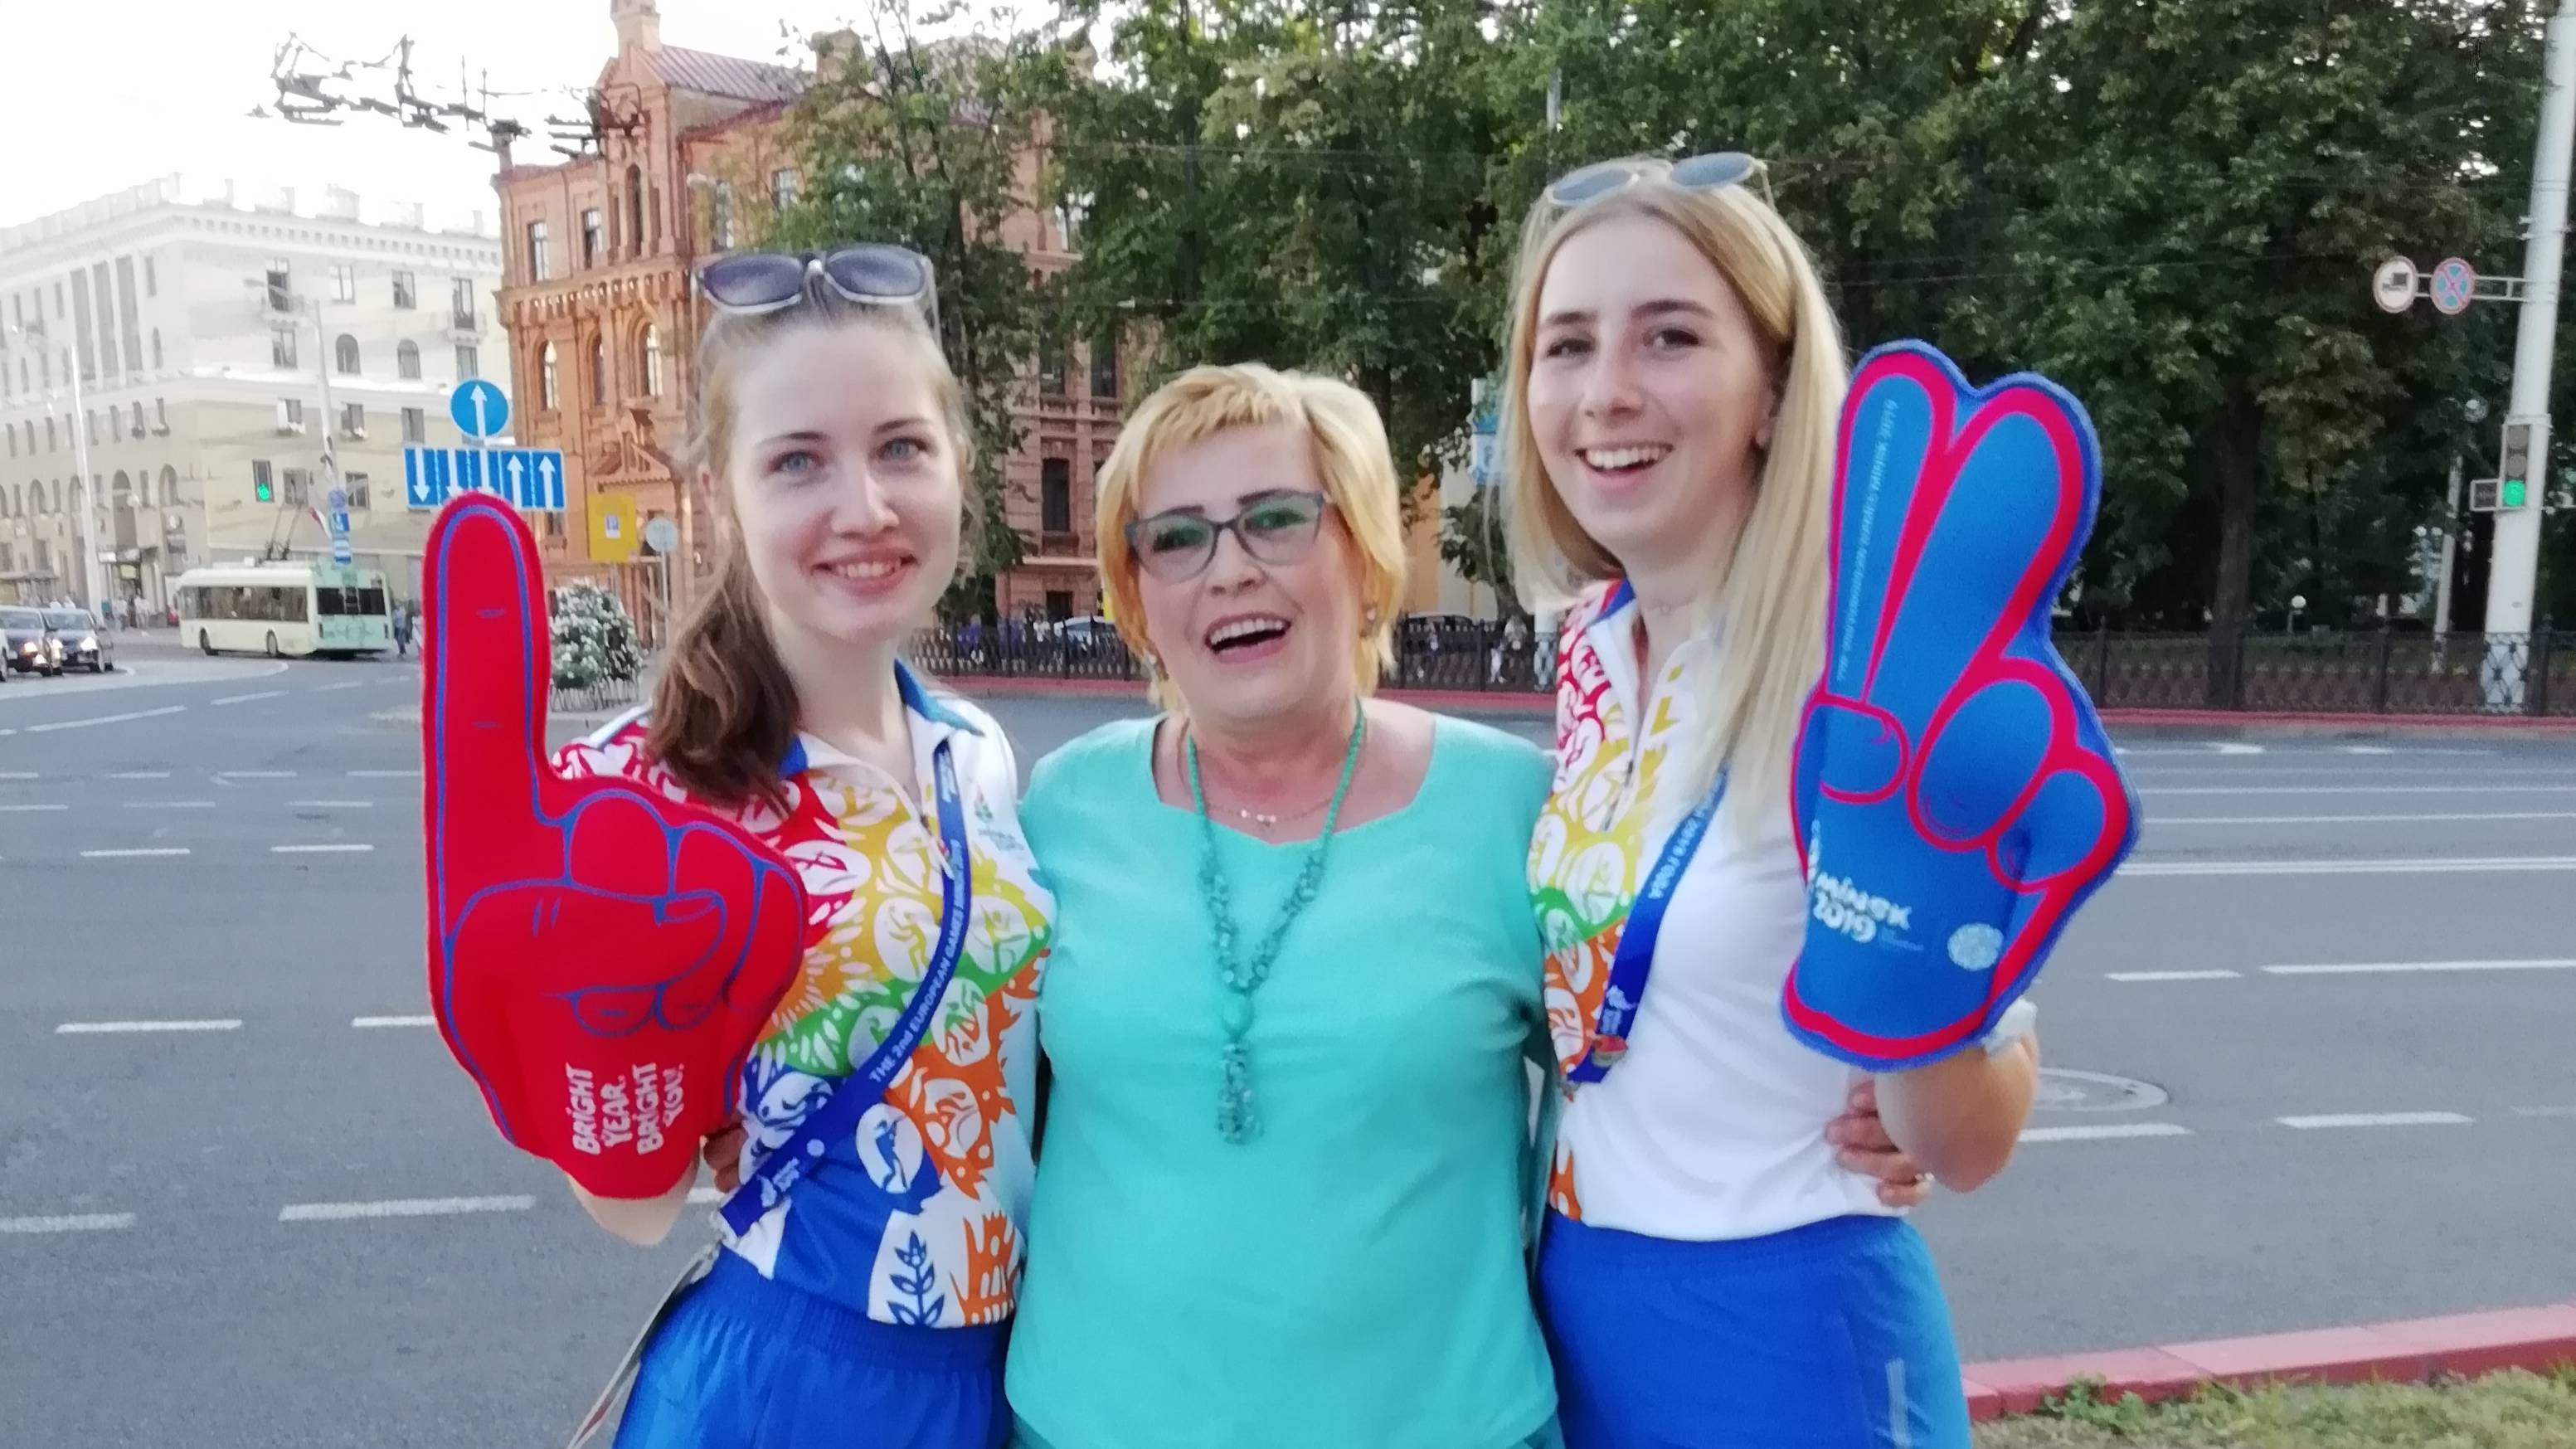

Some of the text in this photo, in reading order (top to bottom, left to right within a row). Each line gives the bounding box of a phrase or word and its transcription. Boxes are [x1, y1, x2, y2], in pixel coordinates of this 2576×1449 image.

[1812, 891, 1877, 944] 2019
[868, 1054, 897, 1083] THE
[909, 956, 951, 1033] EUROPEAN
